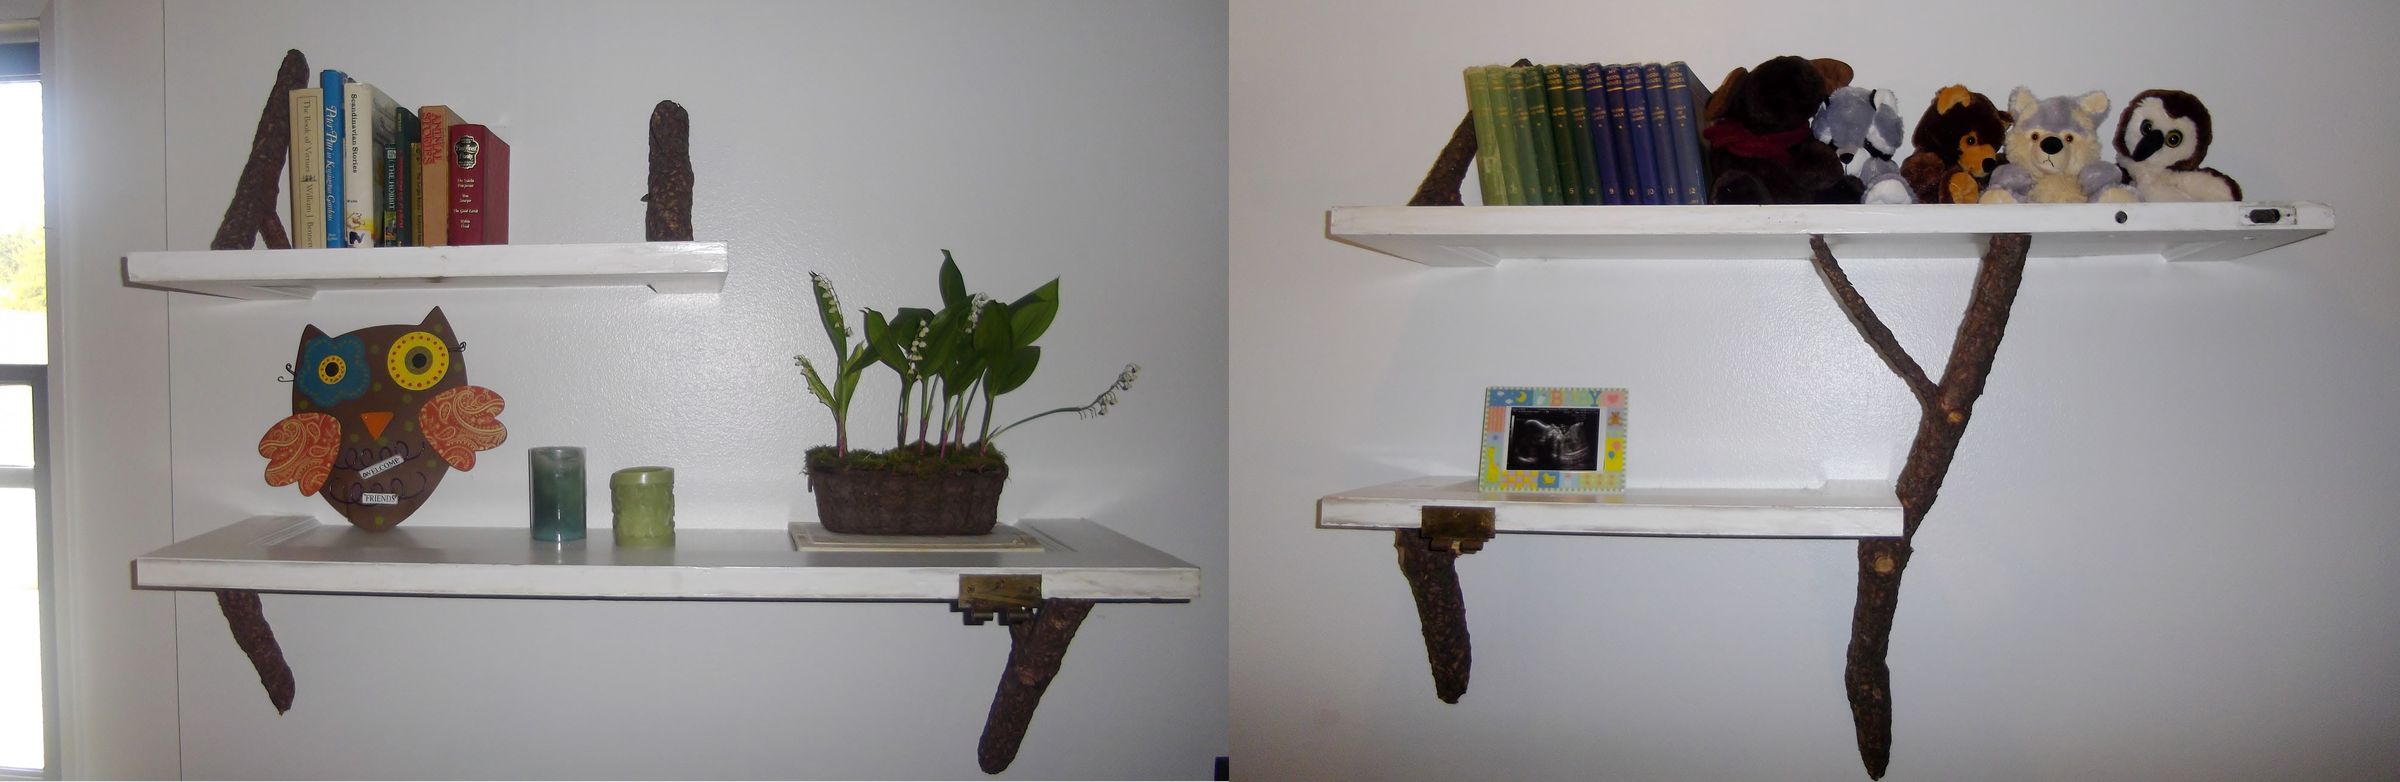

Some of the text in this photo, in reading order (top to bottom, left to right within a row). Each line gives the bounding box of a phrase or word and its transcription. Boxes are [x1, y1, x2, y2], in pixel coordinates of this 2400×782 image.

[325, 105, 338, 129] Peter
[350, 93, 358, 146] Scandinavian
[303, 101, 312, 173] The Book of Virtues
[326, 130, 338, 151] Pan
[423, 112, 435, 165] STORIES
[431, 113, 442, 160] ANIMAL
[305, 184, 313, 213] William
[388, 164, 396, 211] THE HOBBIT
[362, 457, 400, 478] WELCOME
[365, 494, 397, 503] FRIENDS
